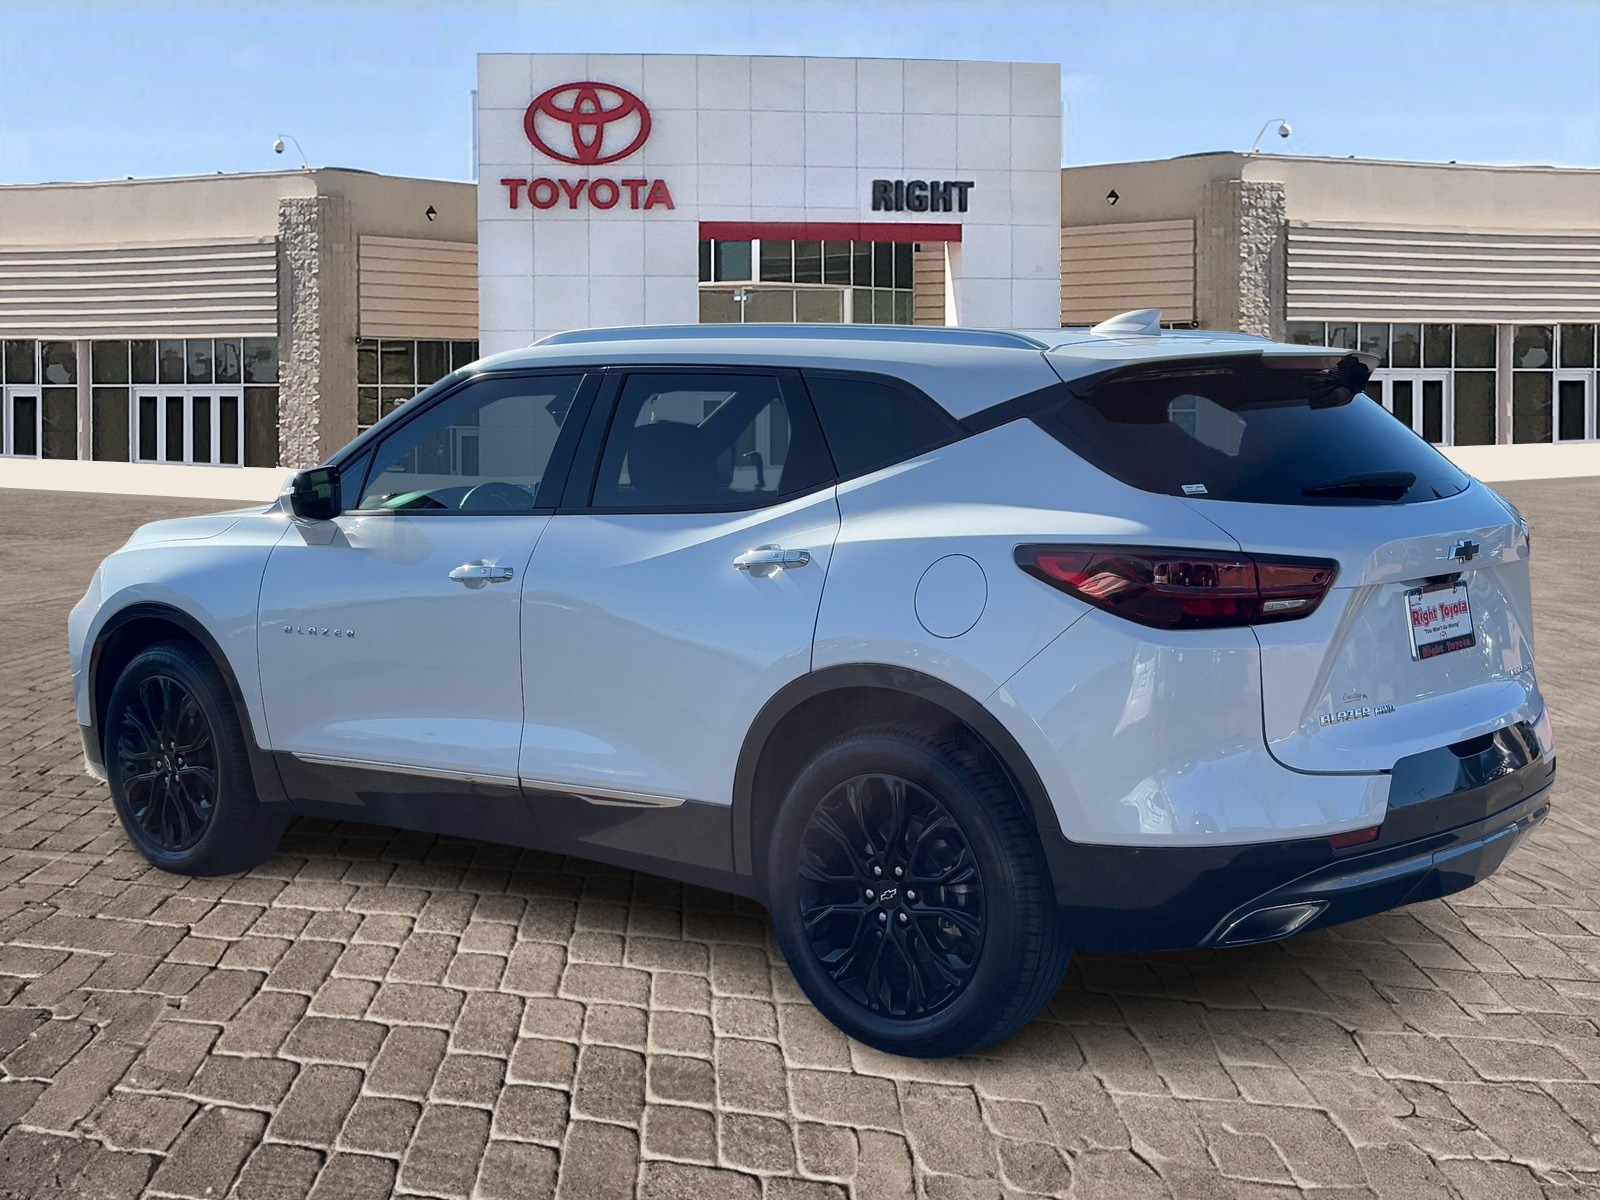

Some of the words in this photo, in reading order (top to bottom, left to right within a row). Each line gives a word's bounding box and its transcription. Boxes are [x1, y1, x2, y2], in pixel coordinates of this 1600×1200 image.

[500, 178, 675, 209] TOYOTA
[872, 179, 975, 212] RIGHT
[1411, 606, 1438, 626] Right
[1439, 600, 1468, 621] Toyota
[283, 625, 355, 638] BLAZER
[1422, 644, 1444, 657] Right
[1447, 638, 1471, 651] Toyota
[1320, 706, 1370, 726] BLAZER
